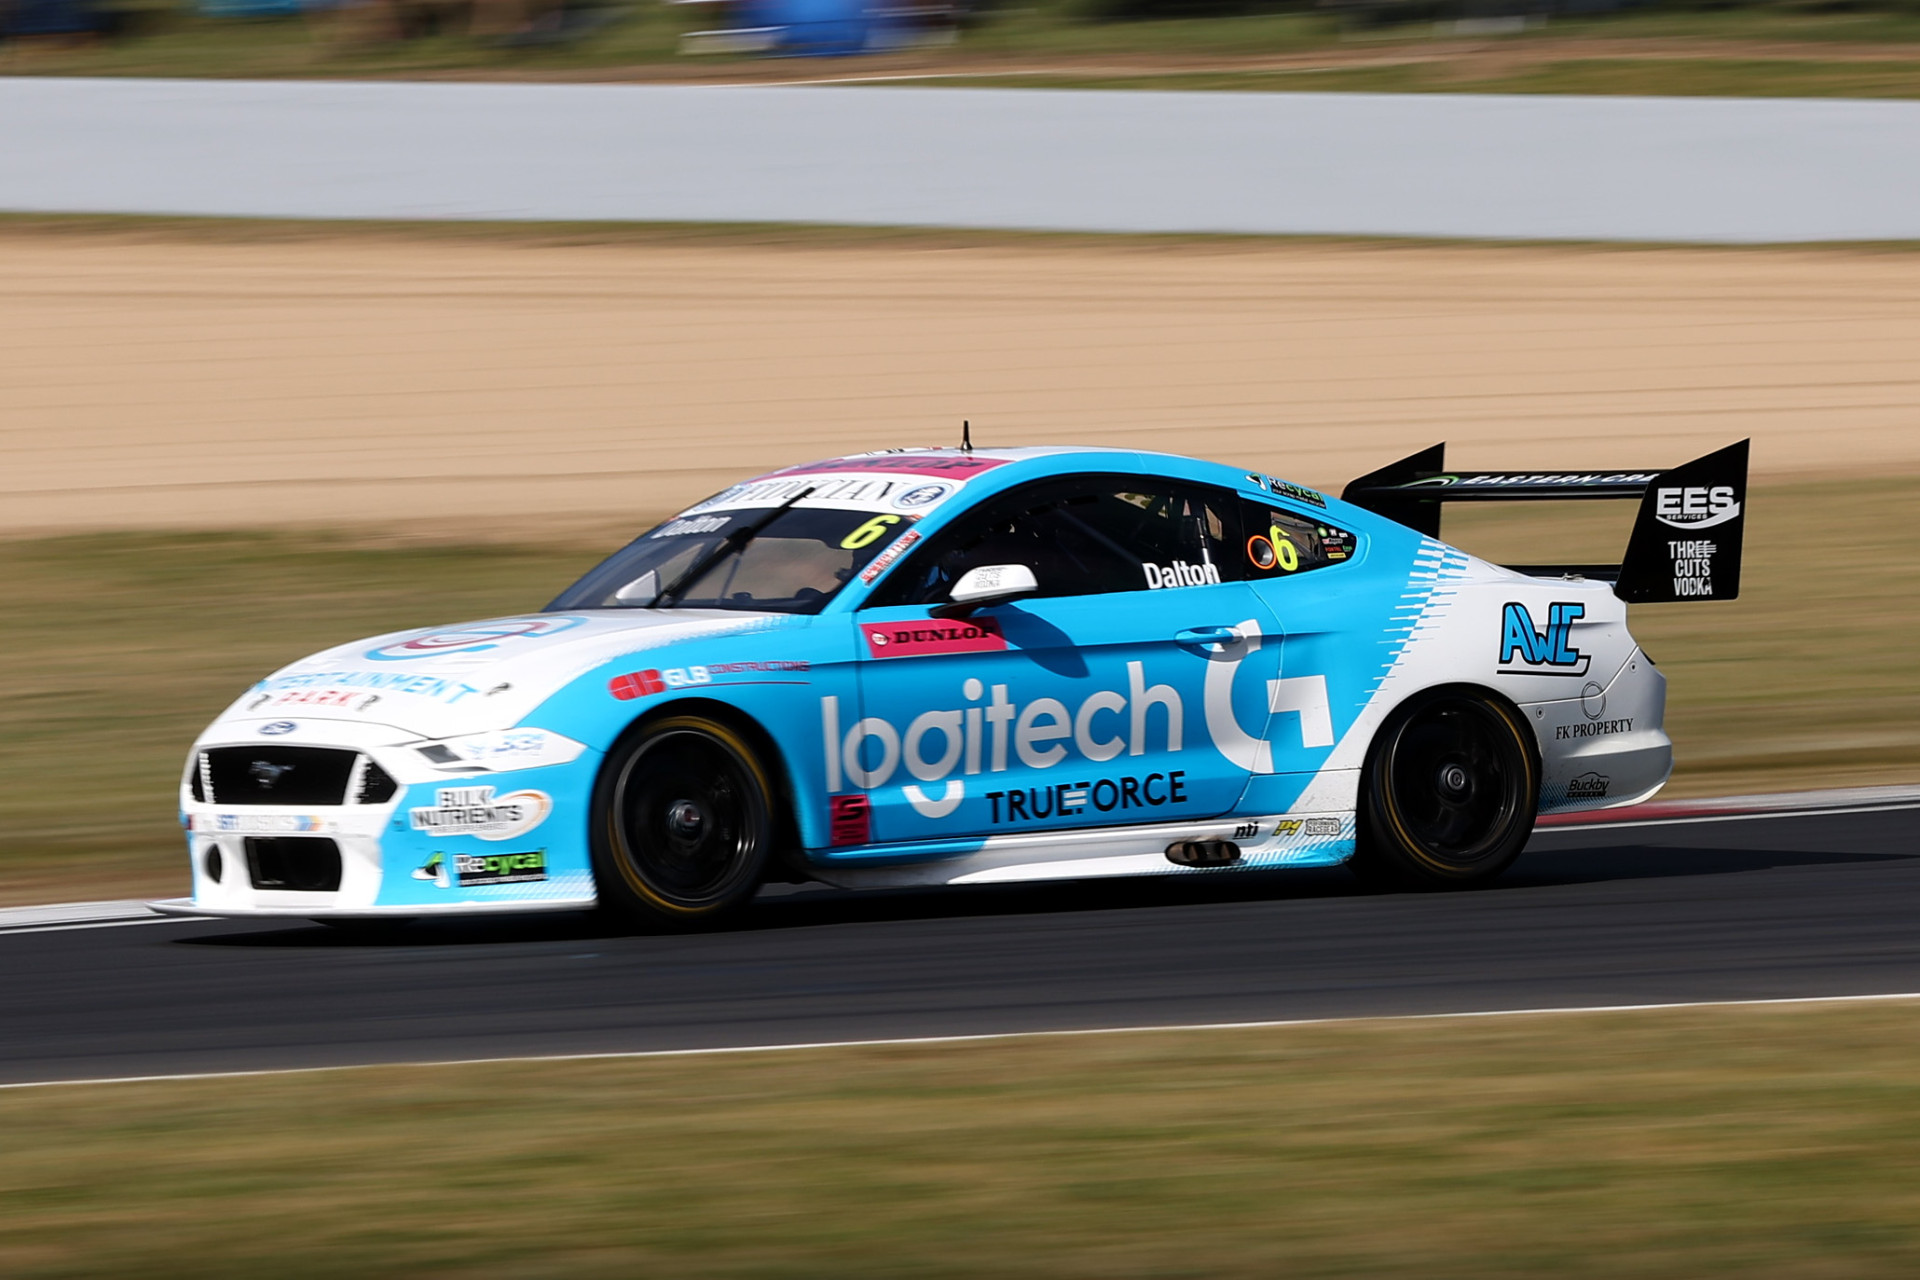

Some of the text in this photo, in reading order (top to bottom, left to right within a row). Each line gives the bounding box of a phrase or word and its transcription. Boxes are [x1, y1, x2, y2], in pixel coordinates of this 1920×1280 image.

[1266, 475, 1325, 502] Recycal
[1462, 472, 1660, 485] EASTERN CRE
[1656, 486, 1735, 515] EES
[840, 514, 901, 550] 6
[1269, 525, 1299, 572] 6
[1667, 540, 1715, 559] THREE
[1141, 560, 1221, 590] Dalton
[1675, 559, 1711, 577] CUTS
[1673, 577, 1713, 596] VODKA
[893, 626, 998, 644] DUNLOP
[820, 660, 1184, 819] logitech
[1555, 718, 1634, 740] FK PROPERTY
[985, 770, 1188, 824] TRUEFORCE
[1568, 778, 1610, 794] Buckby
[1233, 821, 1260, 838] nti
